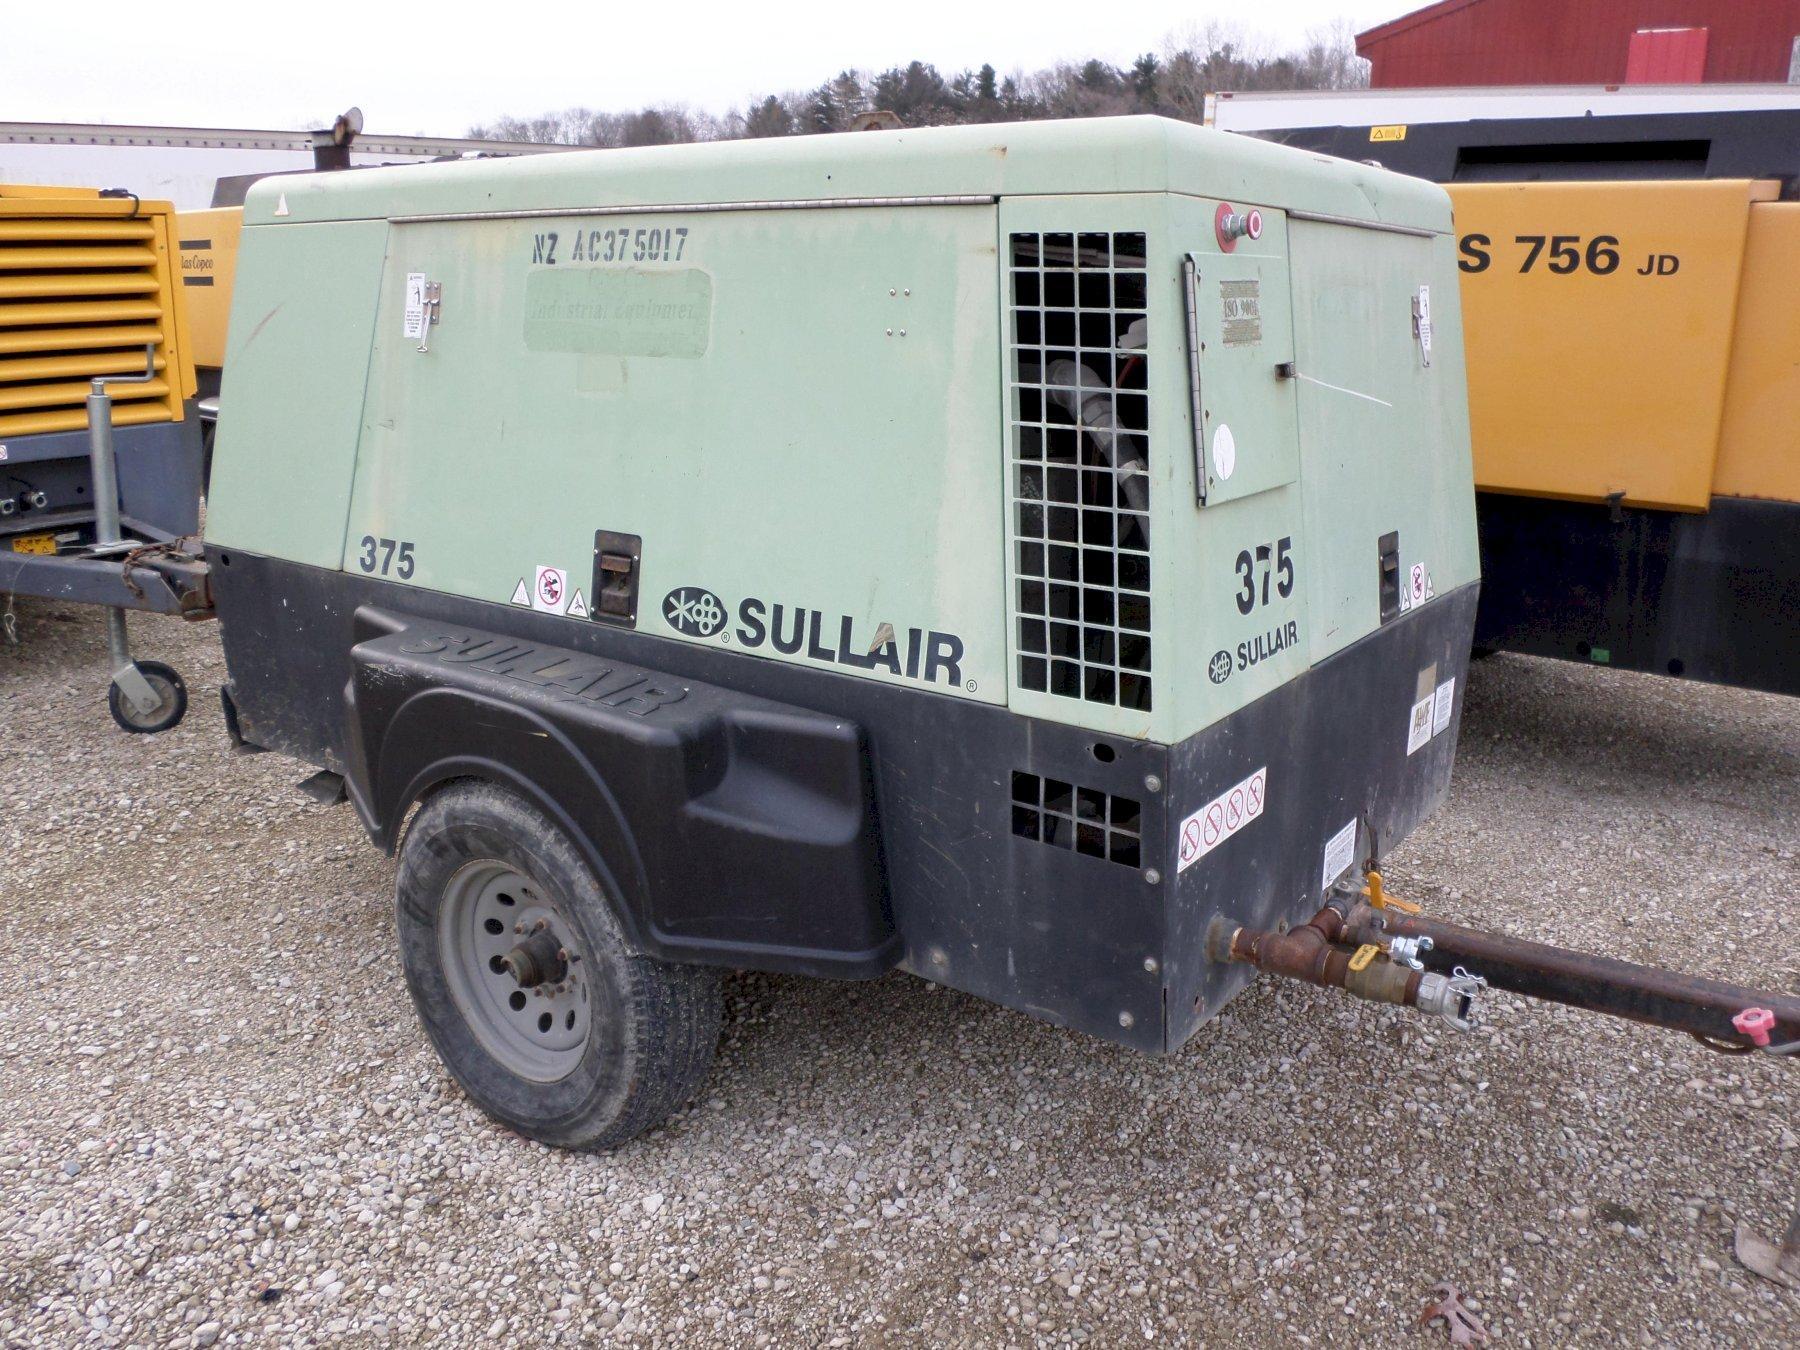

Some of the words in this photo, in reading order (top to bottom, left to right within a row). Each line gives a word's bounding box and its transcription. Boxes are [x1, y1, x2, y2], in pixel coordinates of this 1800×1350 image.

[1515, 235, 1620, 275] 756
[1637, 254, 1680, 276] JD
[1223, 299, 1238, 318] ISO
[359, 535, 415, 581] 375
[1235, 536, 1294, 616] 375
[736, 598, 964, 687] SULLAIR
[1237, 620, 1298, 671] SULLAIR
